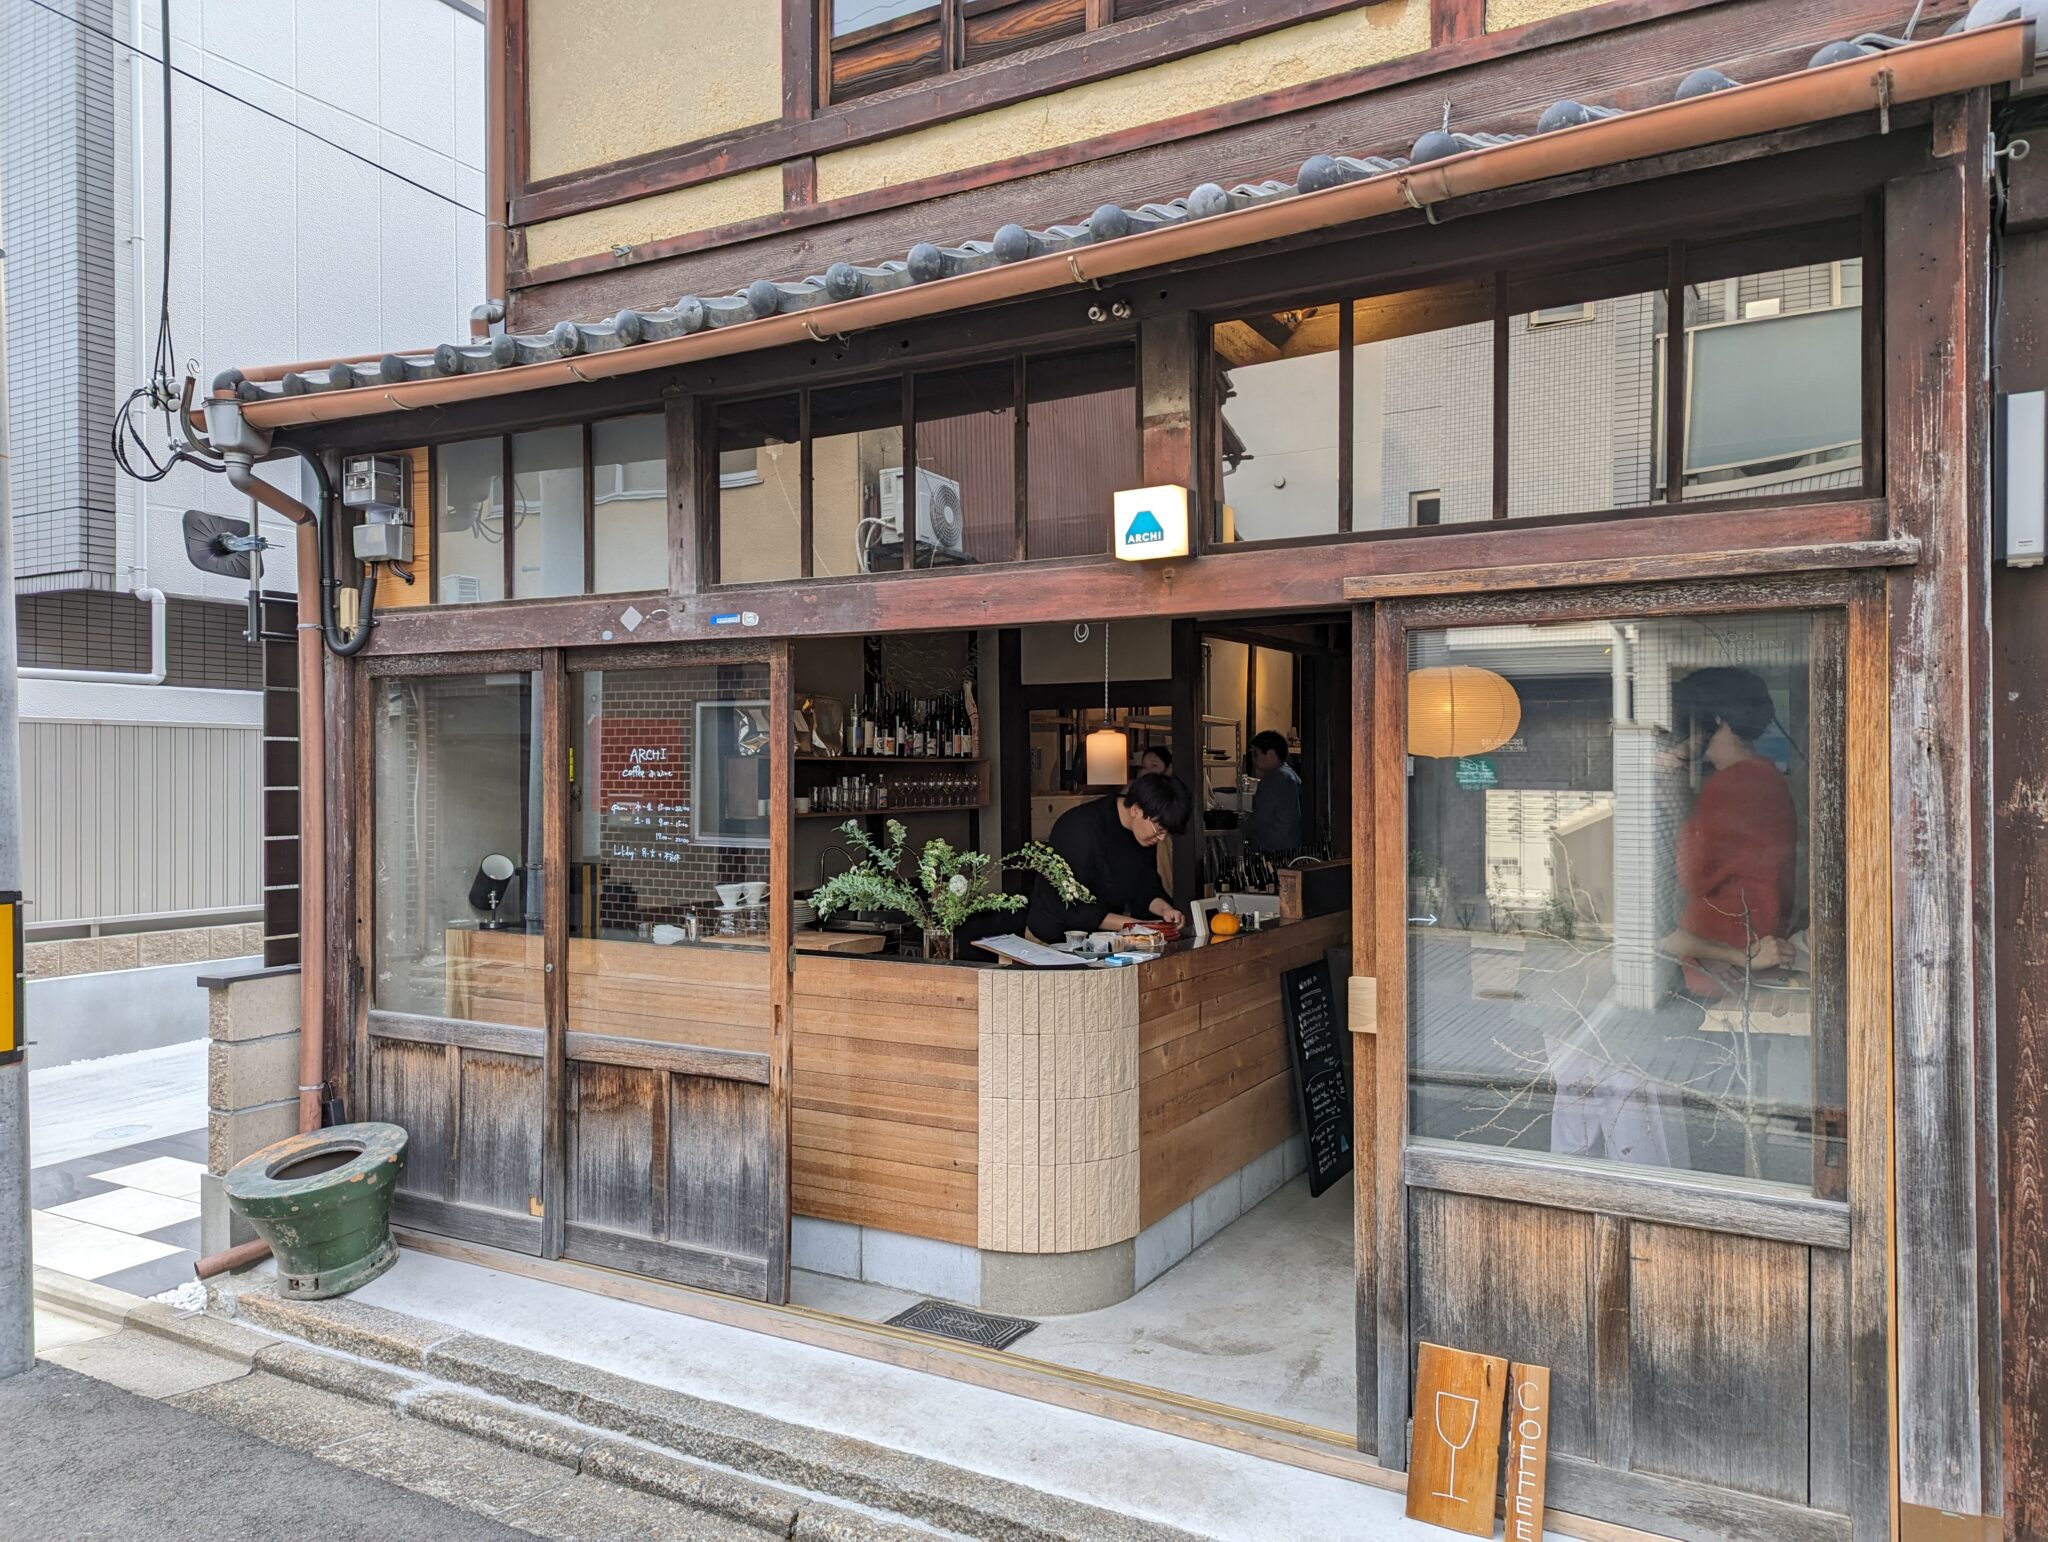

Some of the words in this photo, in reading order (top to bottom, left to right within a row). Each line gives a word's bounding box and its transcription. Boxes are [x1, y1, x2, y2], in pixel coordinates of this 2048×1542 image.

[1127, 531, 1162, 544] ARCHI
[630, 748, 667, 763] ARCHI
[1516, 1382, 1542, 1542] COFFEE
